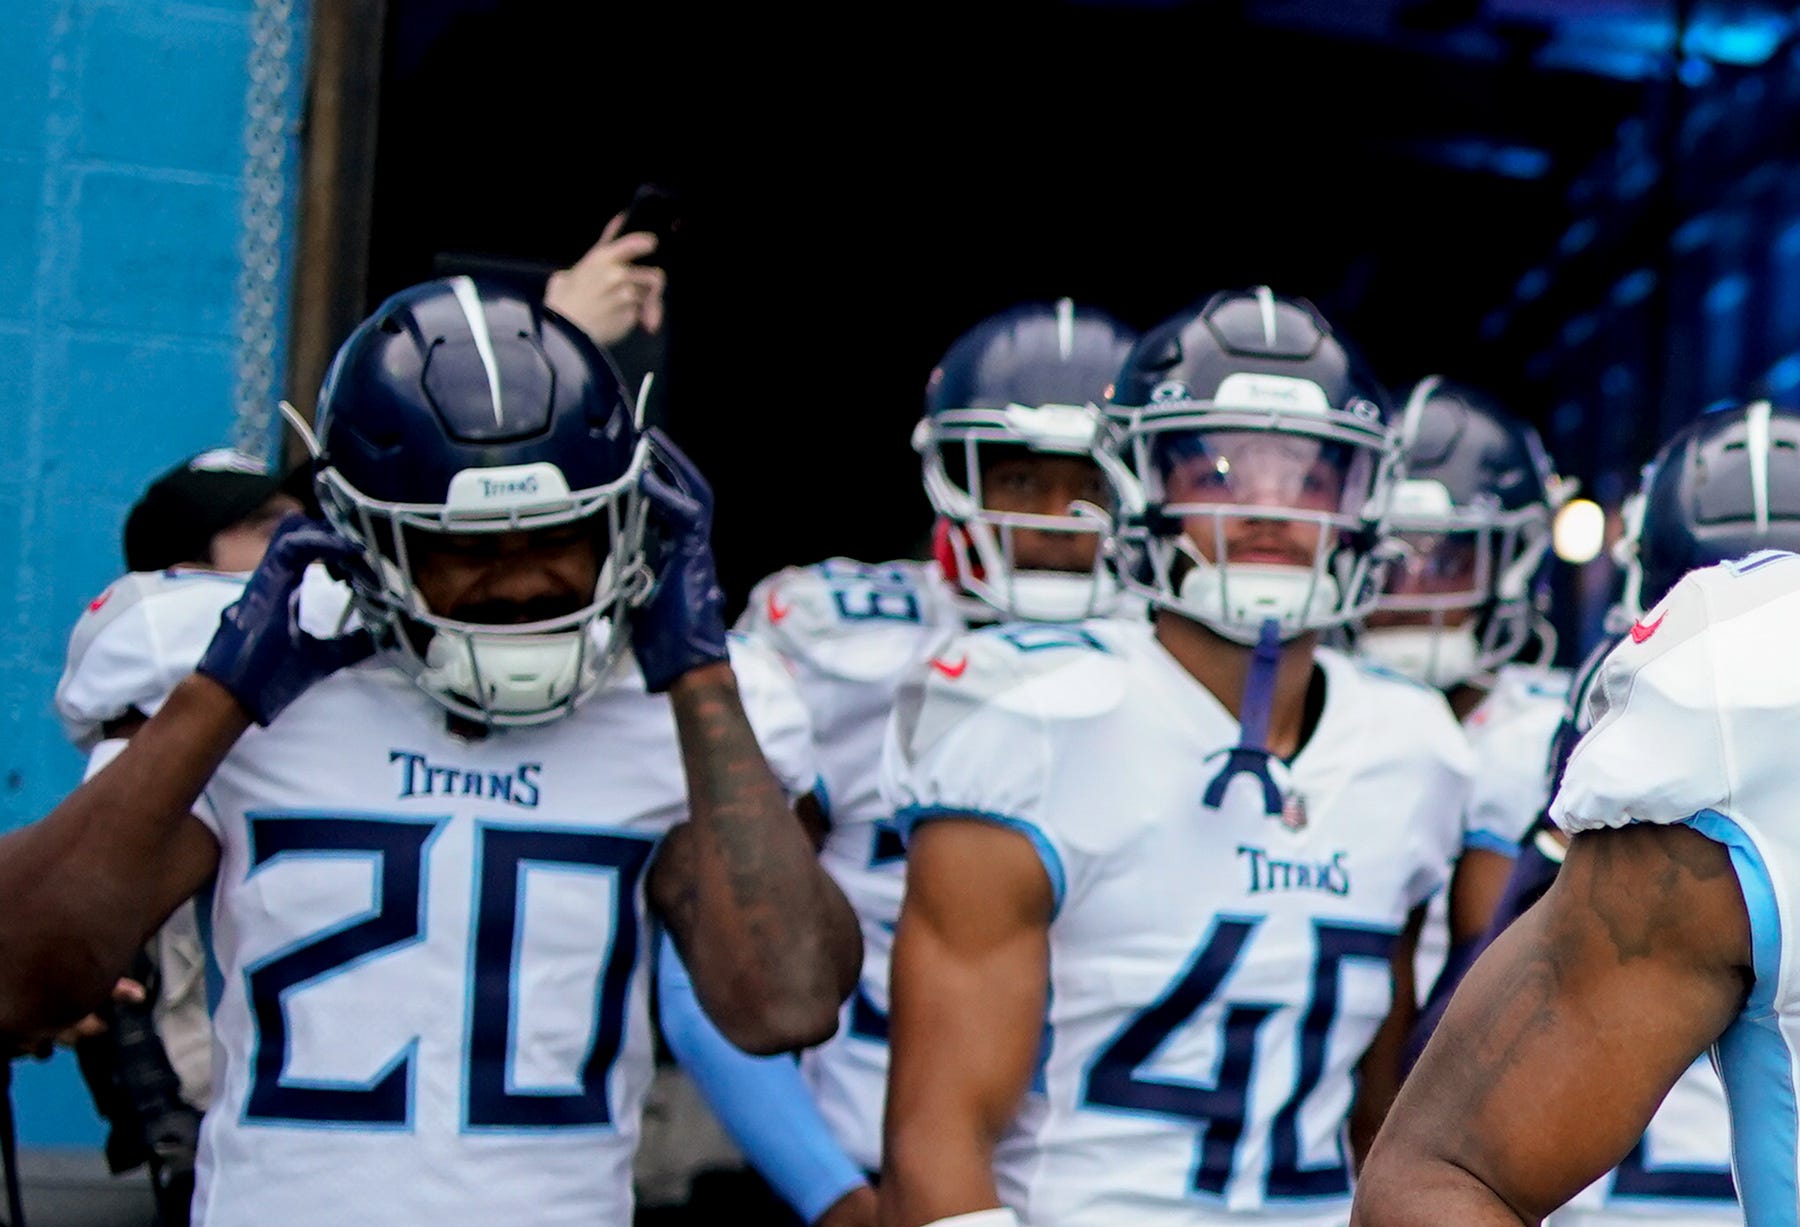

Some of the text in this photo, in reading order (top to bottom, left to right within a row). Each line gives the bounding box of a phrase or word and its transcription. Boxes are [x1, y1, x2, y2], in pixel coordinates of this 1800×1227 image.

[390, 749, 543, 808] TITANS
[1237, 845, 1352, 897] TITANS
[238, 809, 663, 1135] 20
